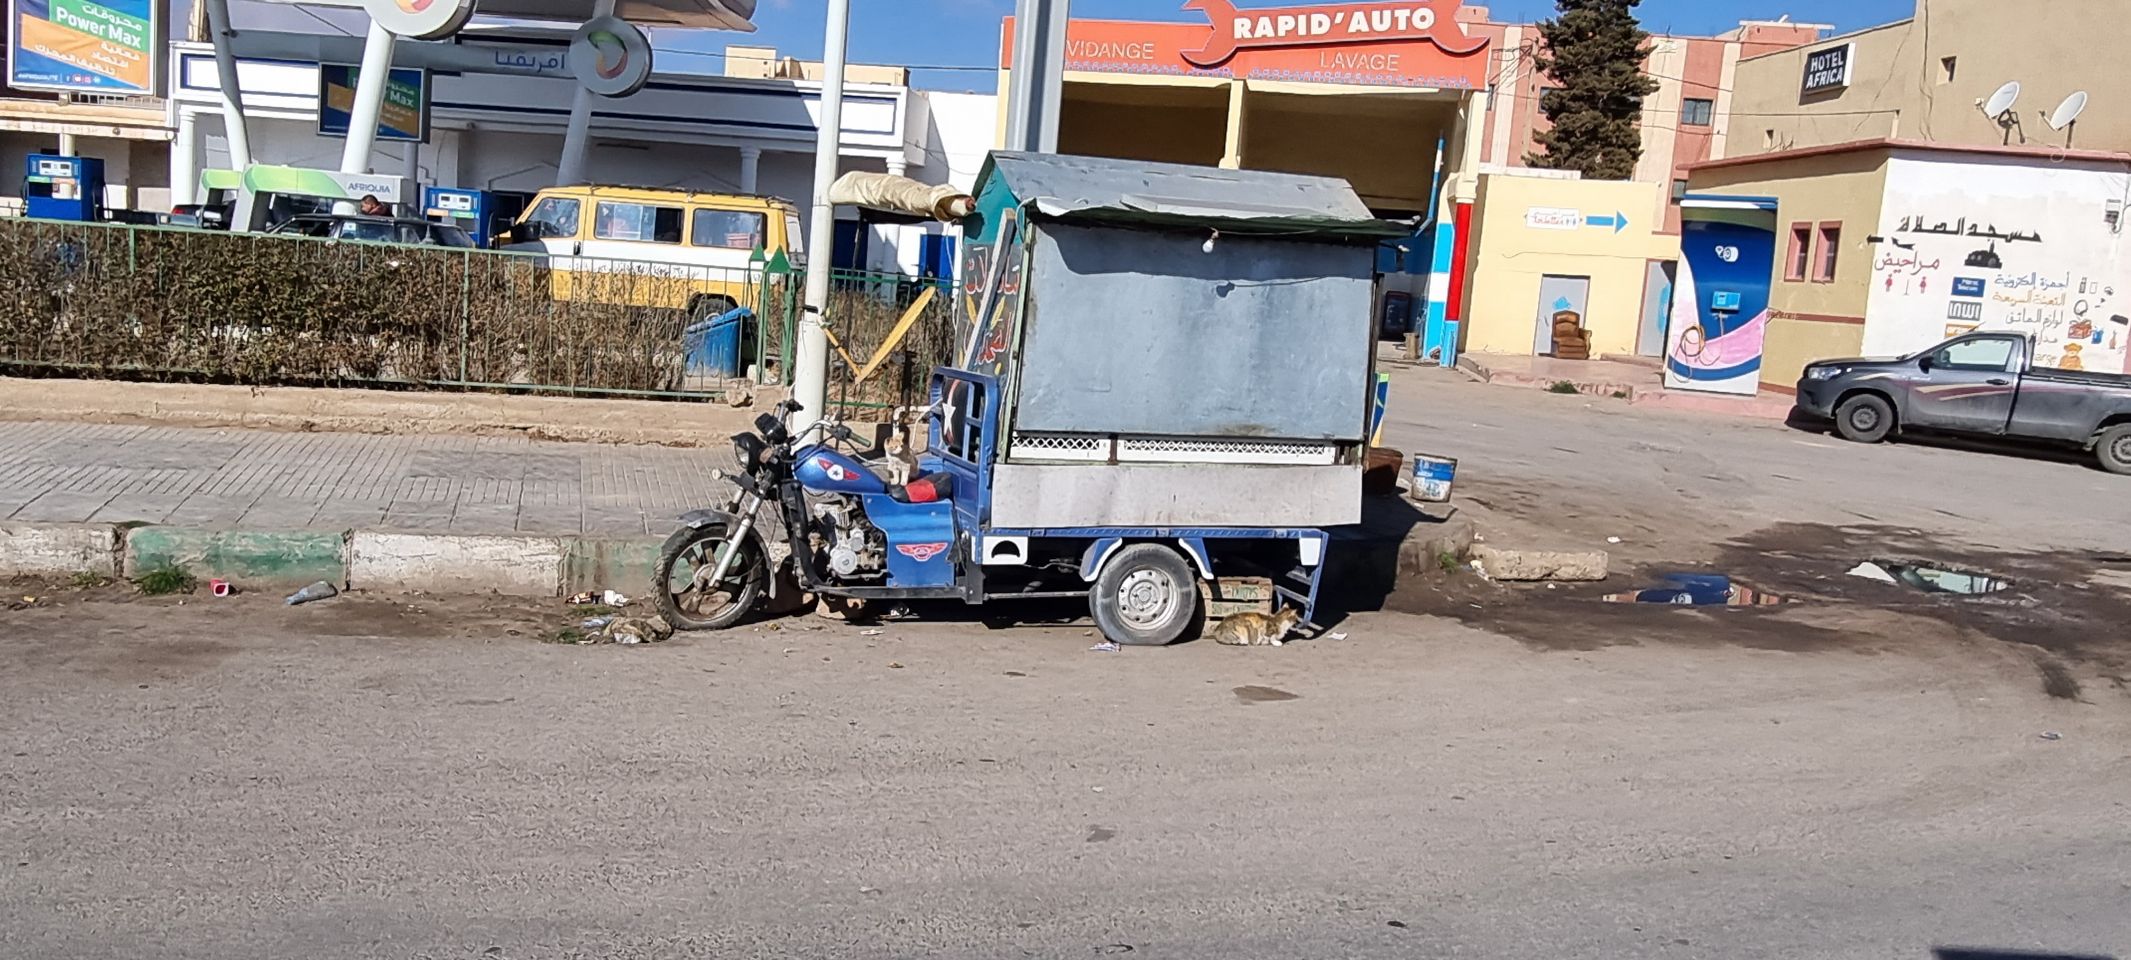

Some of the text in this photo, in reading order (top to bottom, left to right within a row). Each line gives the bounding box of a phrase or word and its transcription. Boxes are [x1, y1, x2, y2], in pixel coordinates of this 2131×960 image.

[56, 6, 142, 49] Power Max
[82, 4, 143, 32] محروقات
[1066, 41, 1155, 60] VIDANGE
[1319, 51, 1400, 72] LAVAGE
[1810, 51, 1844, 72] HOTEL
[1805, 67, 1844, 89] AFRICA
[390, 90, 414, 107] Max
[348, 183, 391, 194] AFRIQUIA
[1896, 215, 2042, 243] مسجد الصلاة
[1874, 250, 1940, 276] مراحيض
